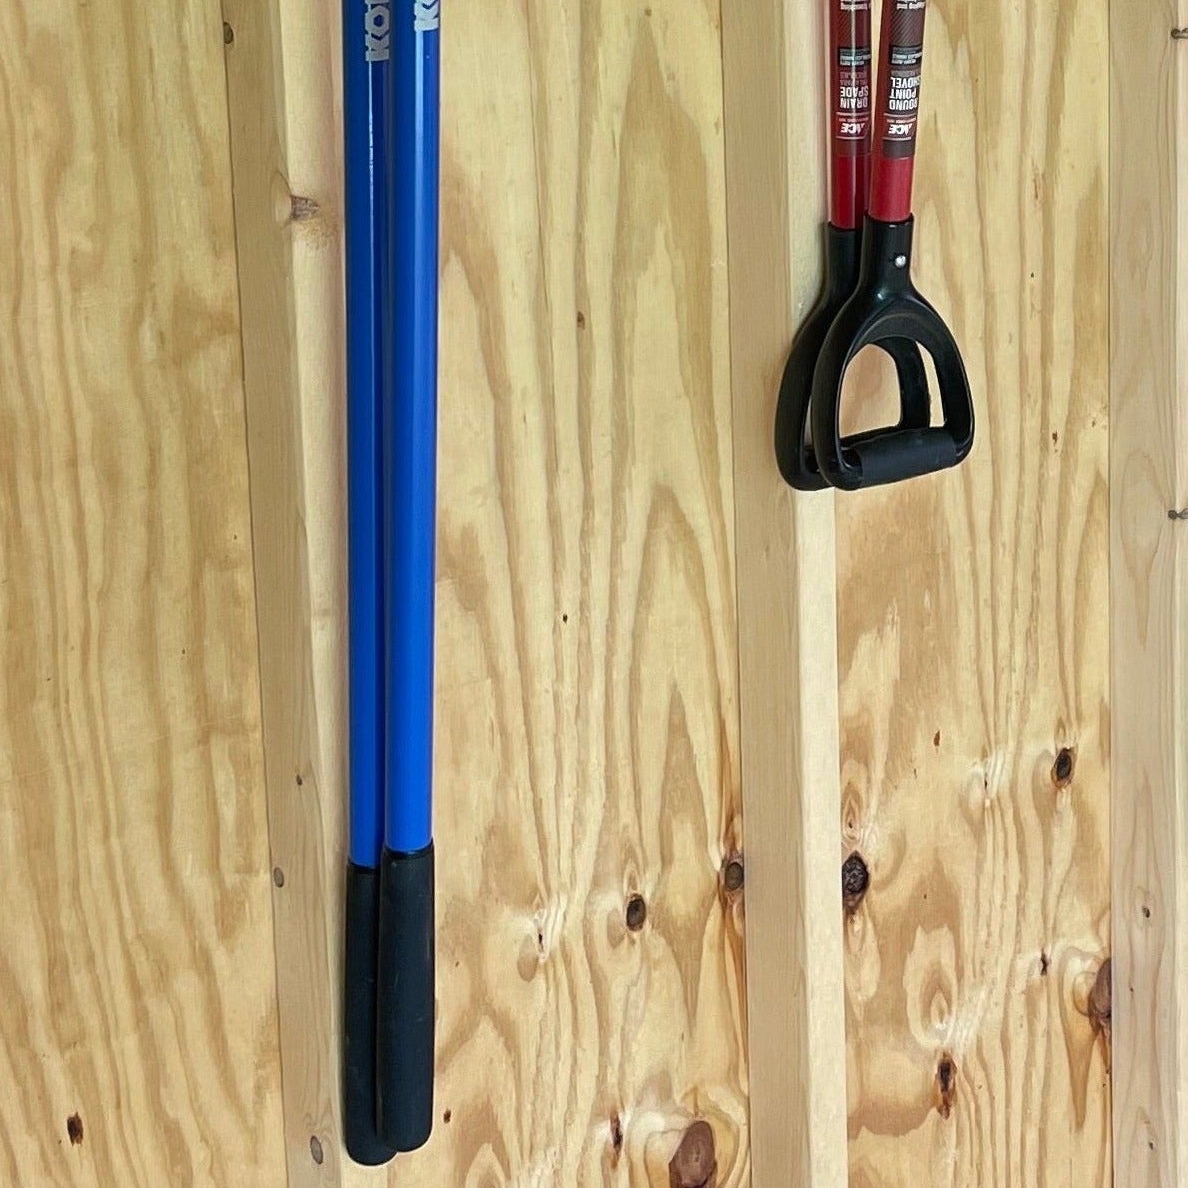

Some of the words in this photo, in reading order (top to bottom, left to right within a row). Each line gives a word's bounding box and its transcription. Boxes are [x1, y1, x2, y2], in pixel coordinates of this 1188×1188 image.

[840, 85, 869, 97] SPADE
[889, 88, 917, 100] POINT
[840, 96, 868, 109] DRAIN
[841, 122, 866, 134] ACE
[888, 123, 913, 135] ACE
